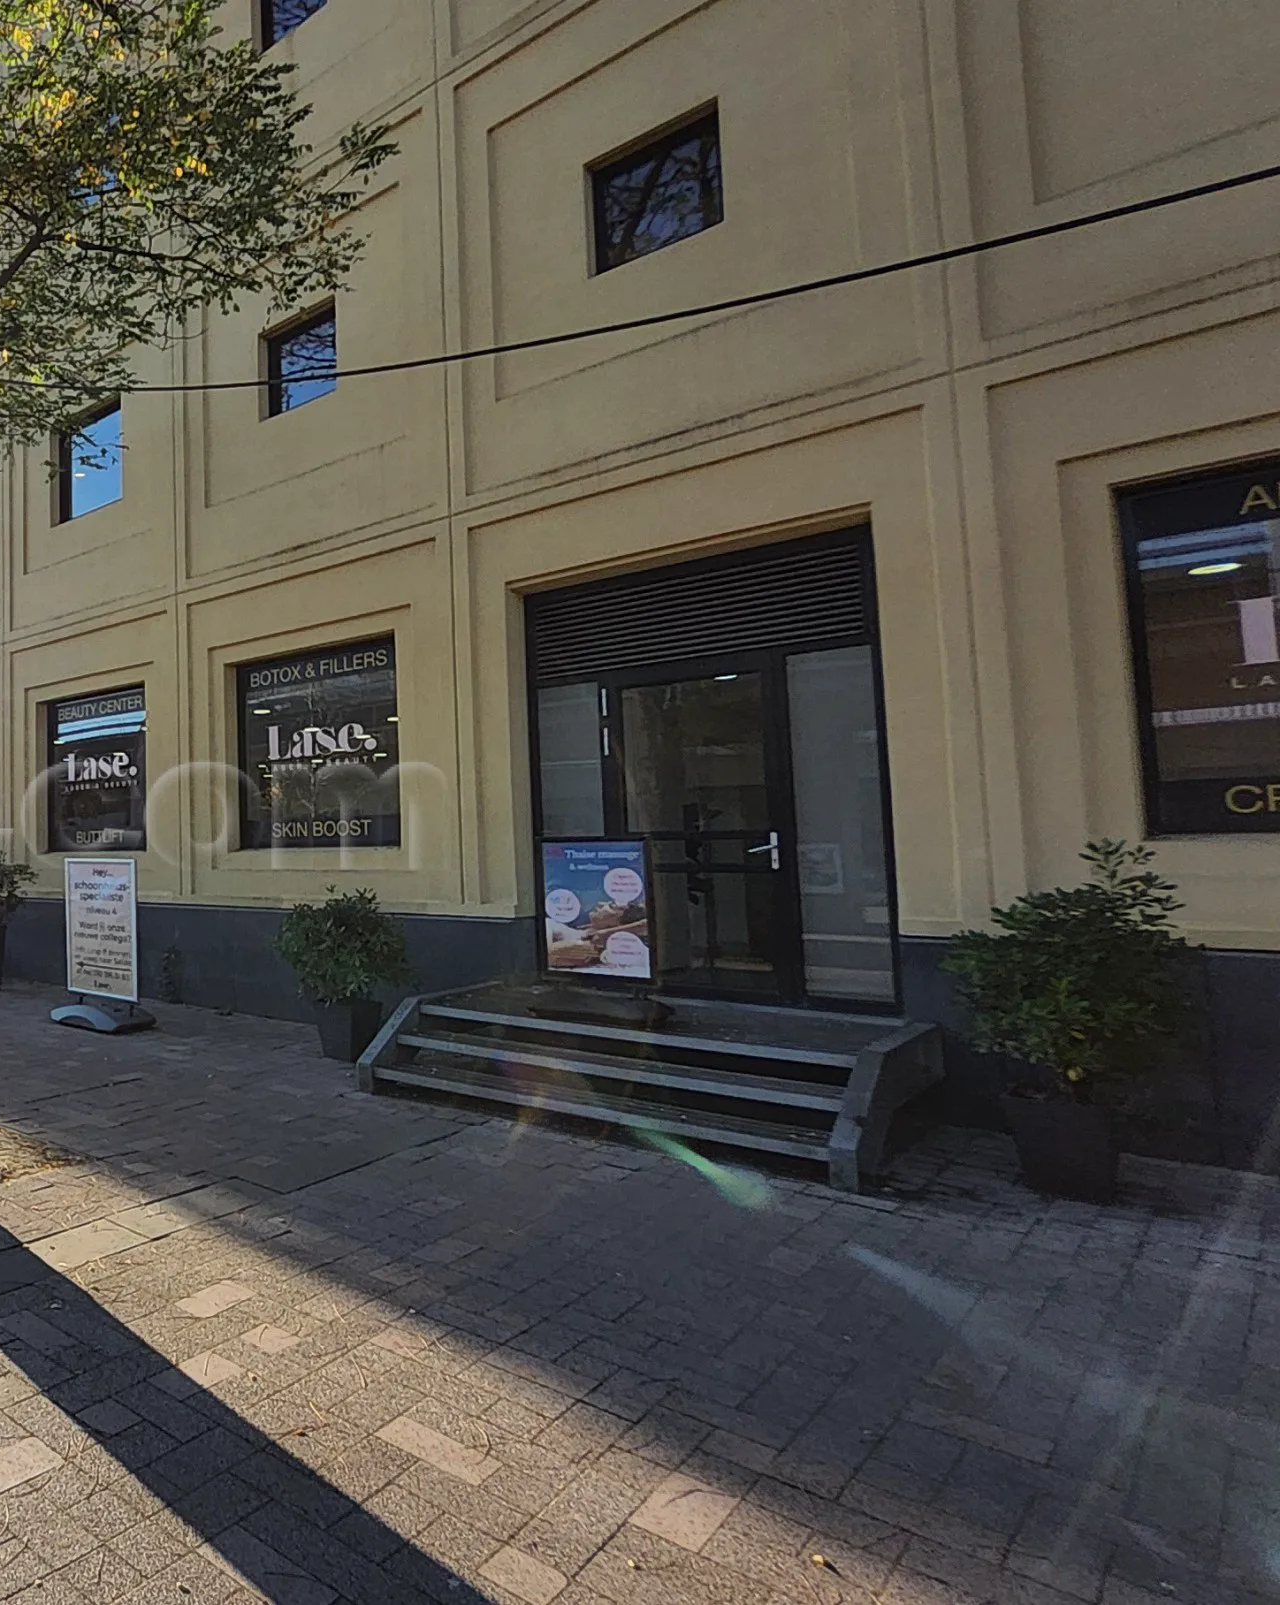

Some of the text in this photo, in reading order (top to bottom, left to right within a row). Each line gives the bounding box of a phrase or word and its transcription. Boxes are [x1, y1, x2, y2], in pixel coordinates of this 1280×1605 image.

[250, 649, 388, 688] BOTOX & FILLERS
[58, 696, 143, 721] BEAUTY CENTER
[266, 723, 377, 761] Lase.
[65, 752, 138, 782] Lase.
[272, 819, 372, 838] SKIN BOOST
